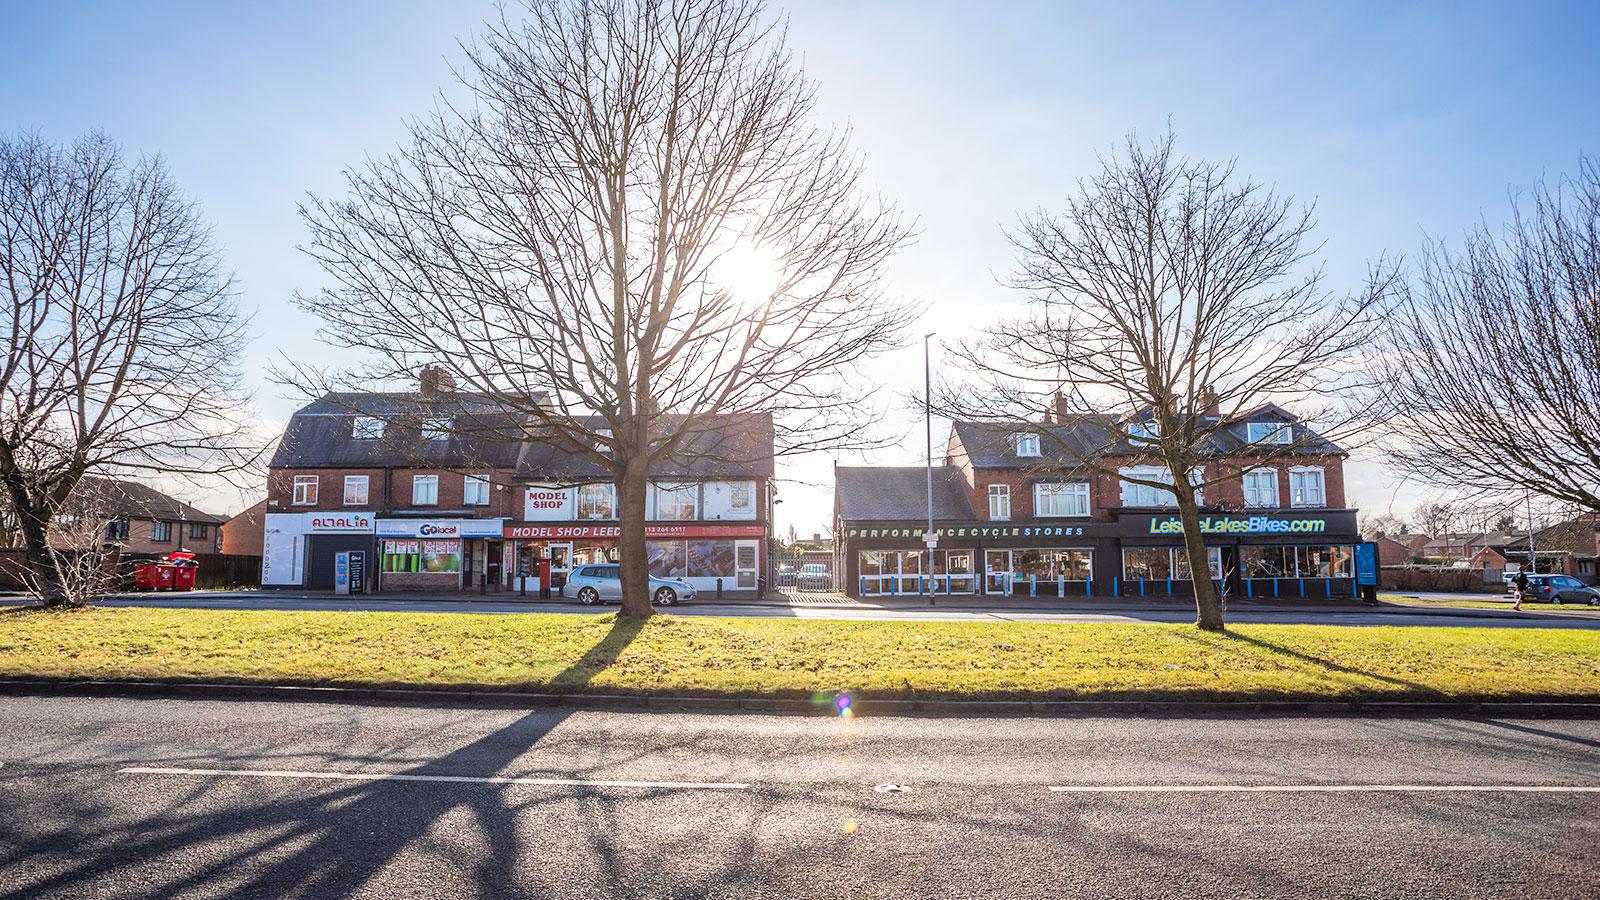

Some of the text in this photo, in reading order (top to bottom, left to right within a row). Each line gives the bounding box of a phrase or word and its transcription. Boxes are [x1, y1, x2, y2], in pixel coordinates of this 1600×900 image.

[529, 492, 567, 500] MODEL
[1151, 517, 1325, 533] LeiseLakesBikes.com
[512, 527, 621, 536] MODEL SHOP LEED
[970, 528, 1019, 536] CYCLE
[1024, 527, 1083, 536] STORES
